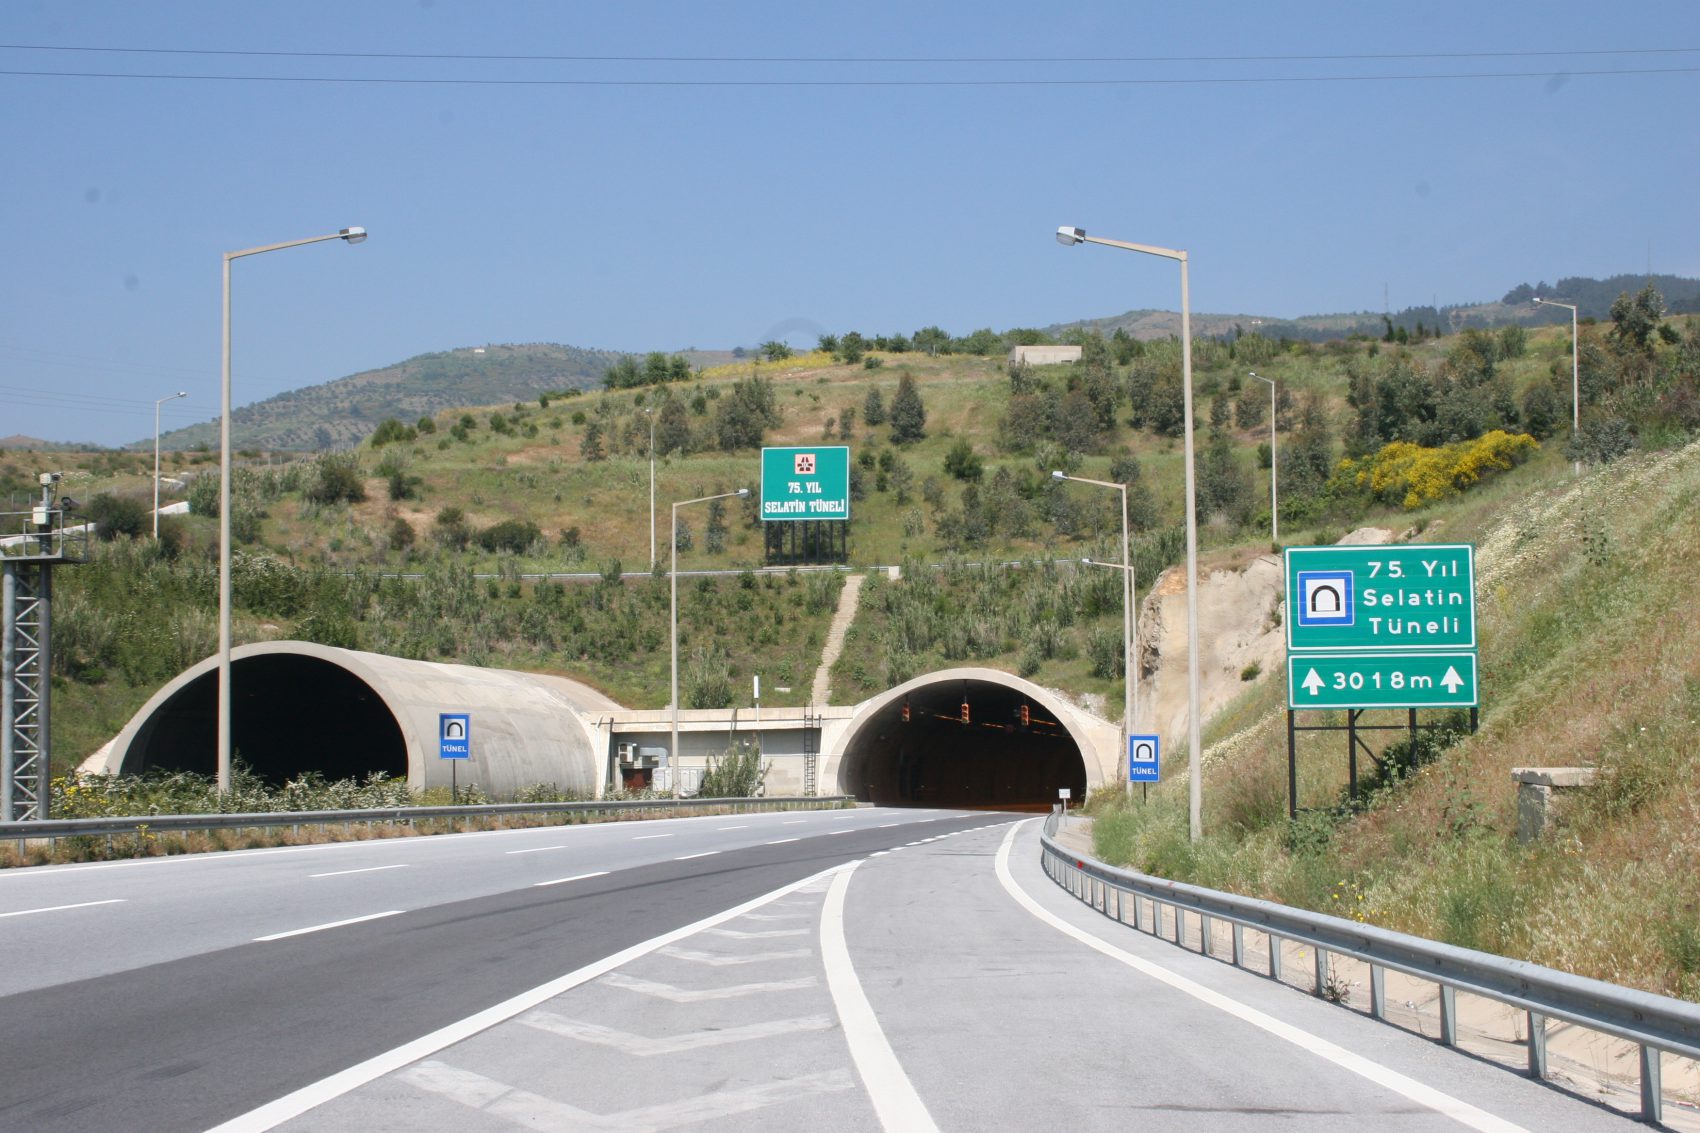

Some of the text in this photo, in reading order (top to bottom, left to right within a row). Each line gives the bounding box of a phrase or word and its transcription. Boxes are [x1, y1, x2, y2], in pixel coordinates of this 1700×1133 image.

[788, 482, 821, 493] 75. YIL
[765, 499, 844, 513] SELATİN TÜNELİ
[1367, 561, 1405, 578] 75.
[1363, 588, 1462, 606] Selatin
[1368, 616, 1459, 635] Tüneli
[1132, 766, 1157, 775] TÜNEL
